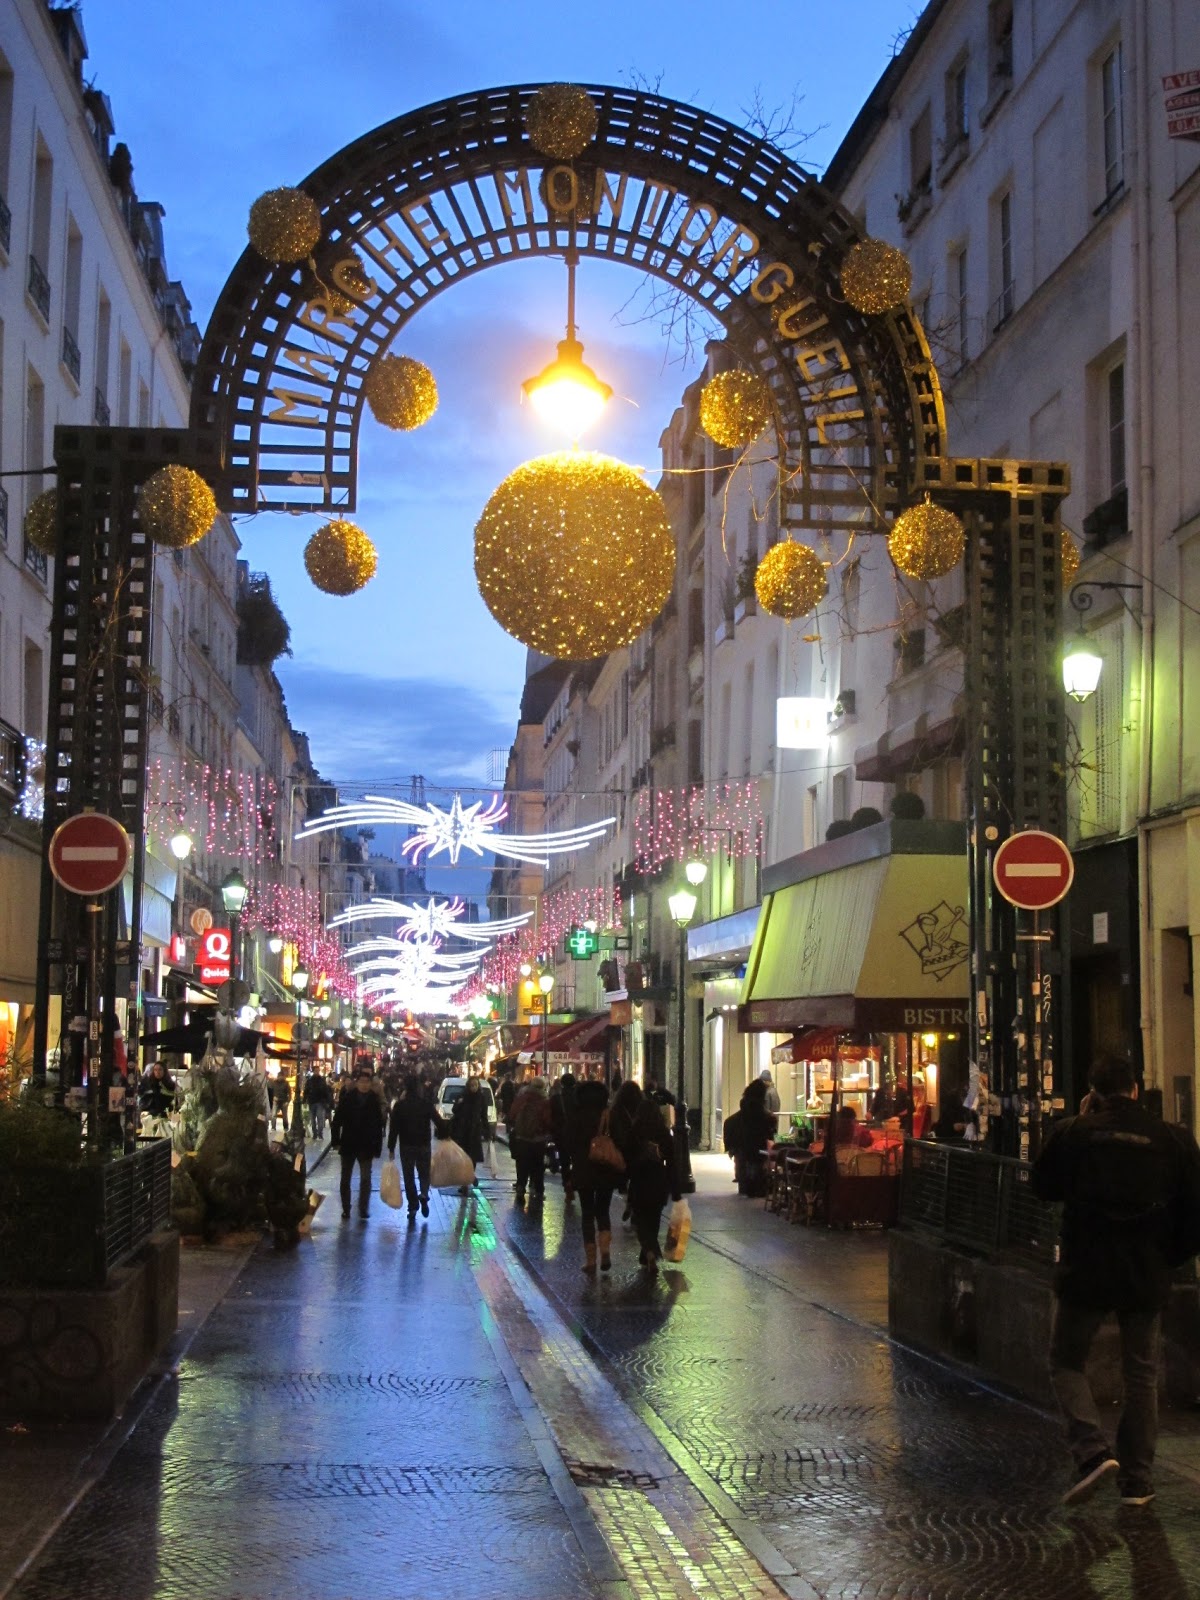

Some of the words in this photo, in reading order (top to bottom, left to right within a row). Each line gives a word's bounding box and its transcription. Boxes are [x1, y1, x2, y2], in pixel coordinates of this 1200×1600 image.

[268, 195, 450, 424] MARCHE
[495, 165, 865, 445] MONTORGUEIL
[206, 933, 230, 960] Q
